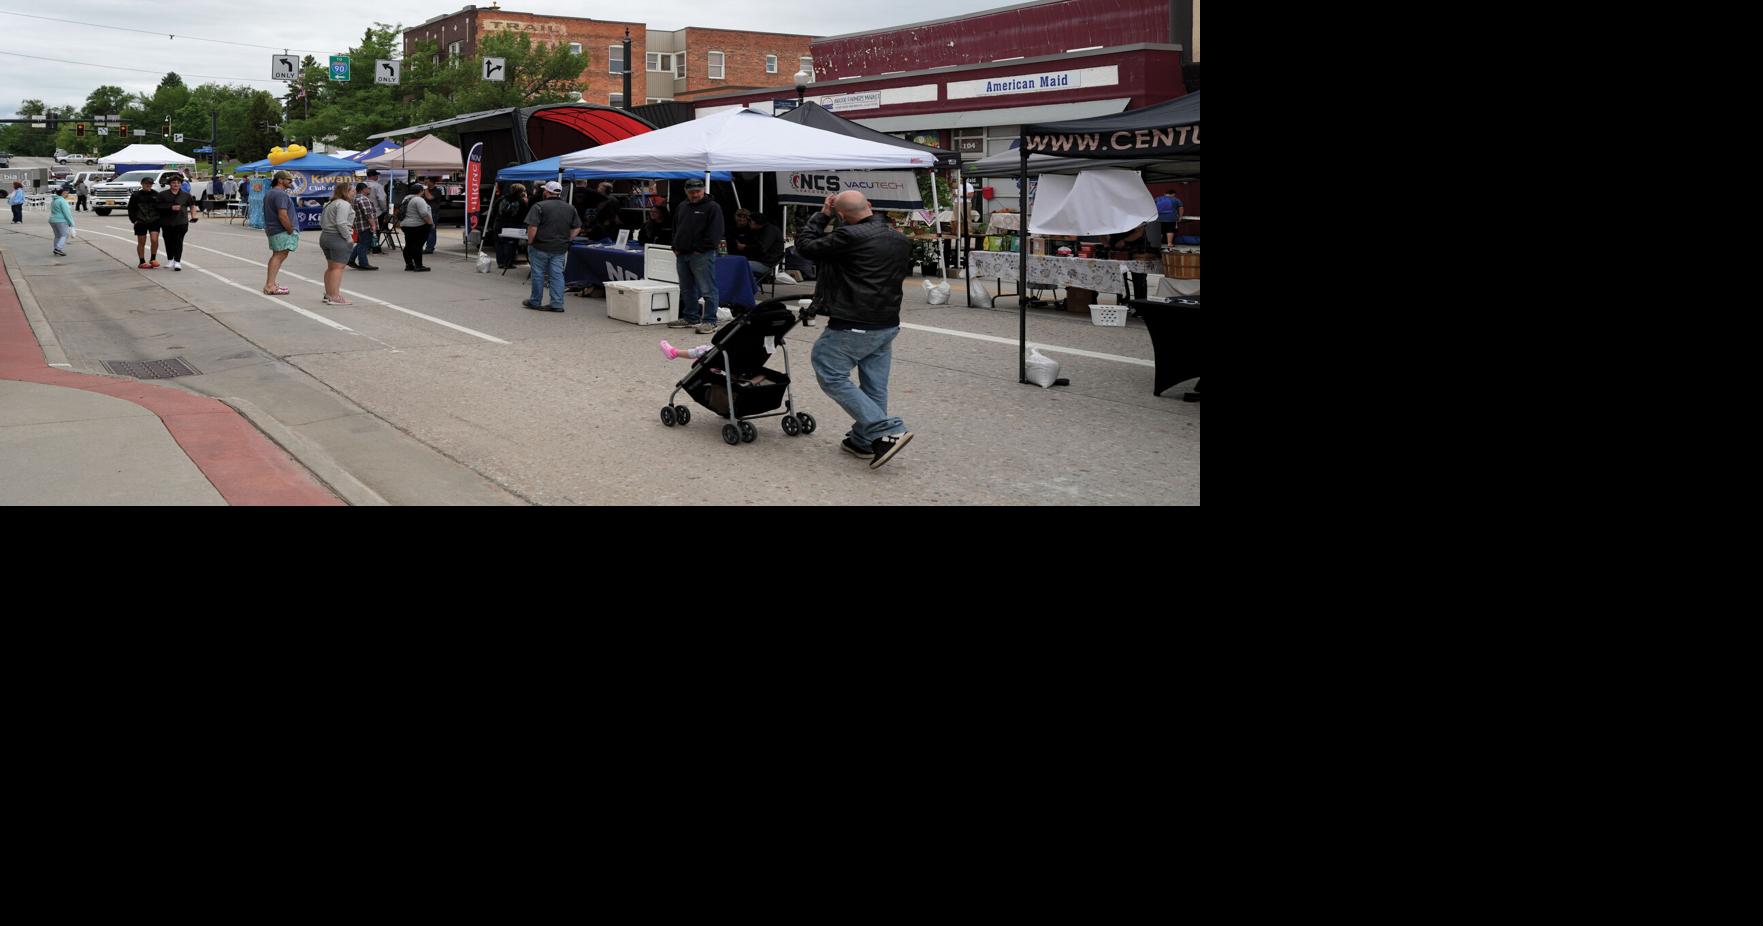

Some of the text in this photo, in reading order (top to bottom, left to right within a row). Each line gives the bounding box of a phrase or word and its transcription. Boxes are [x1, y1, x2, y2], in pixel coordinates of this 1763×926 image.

[489, 21, 560, 33] TRAIL
[334, 65, 345, 73] 90
[986, 74, 1068, 92] American Maid
[311, 174, 363, 184] Kiwanis
[800, 173, 841, 192] NCS
[844, 181, 904, 190] VACUTECH
